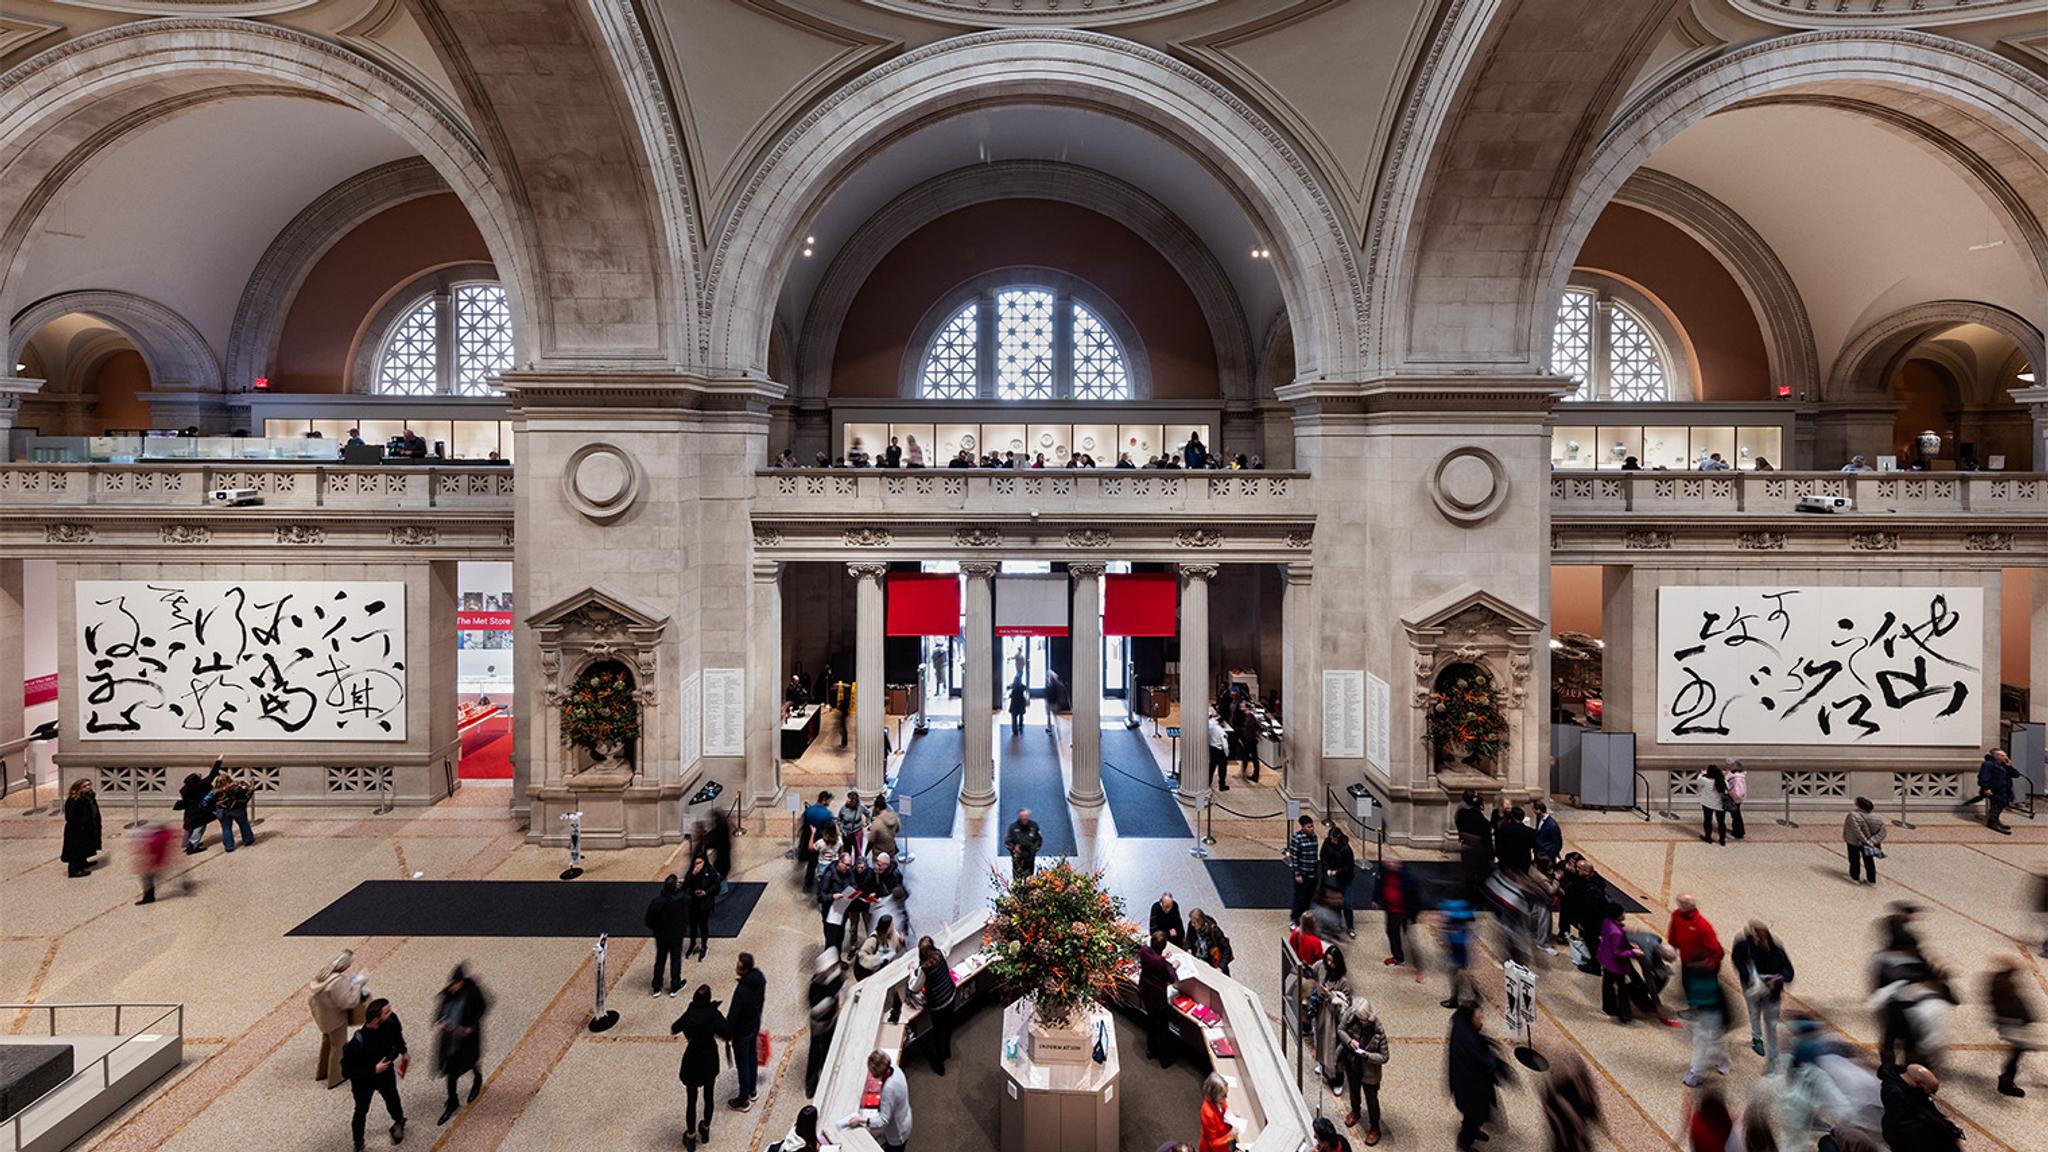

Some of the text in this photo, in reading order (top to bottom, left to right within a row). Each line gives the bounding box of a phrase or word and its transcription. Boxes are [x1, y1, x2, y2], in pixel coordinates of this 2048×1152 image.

[457, 617, 511, 625] The Met Store
